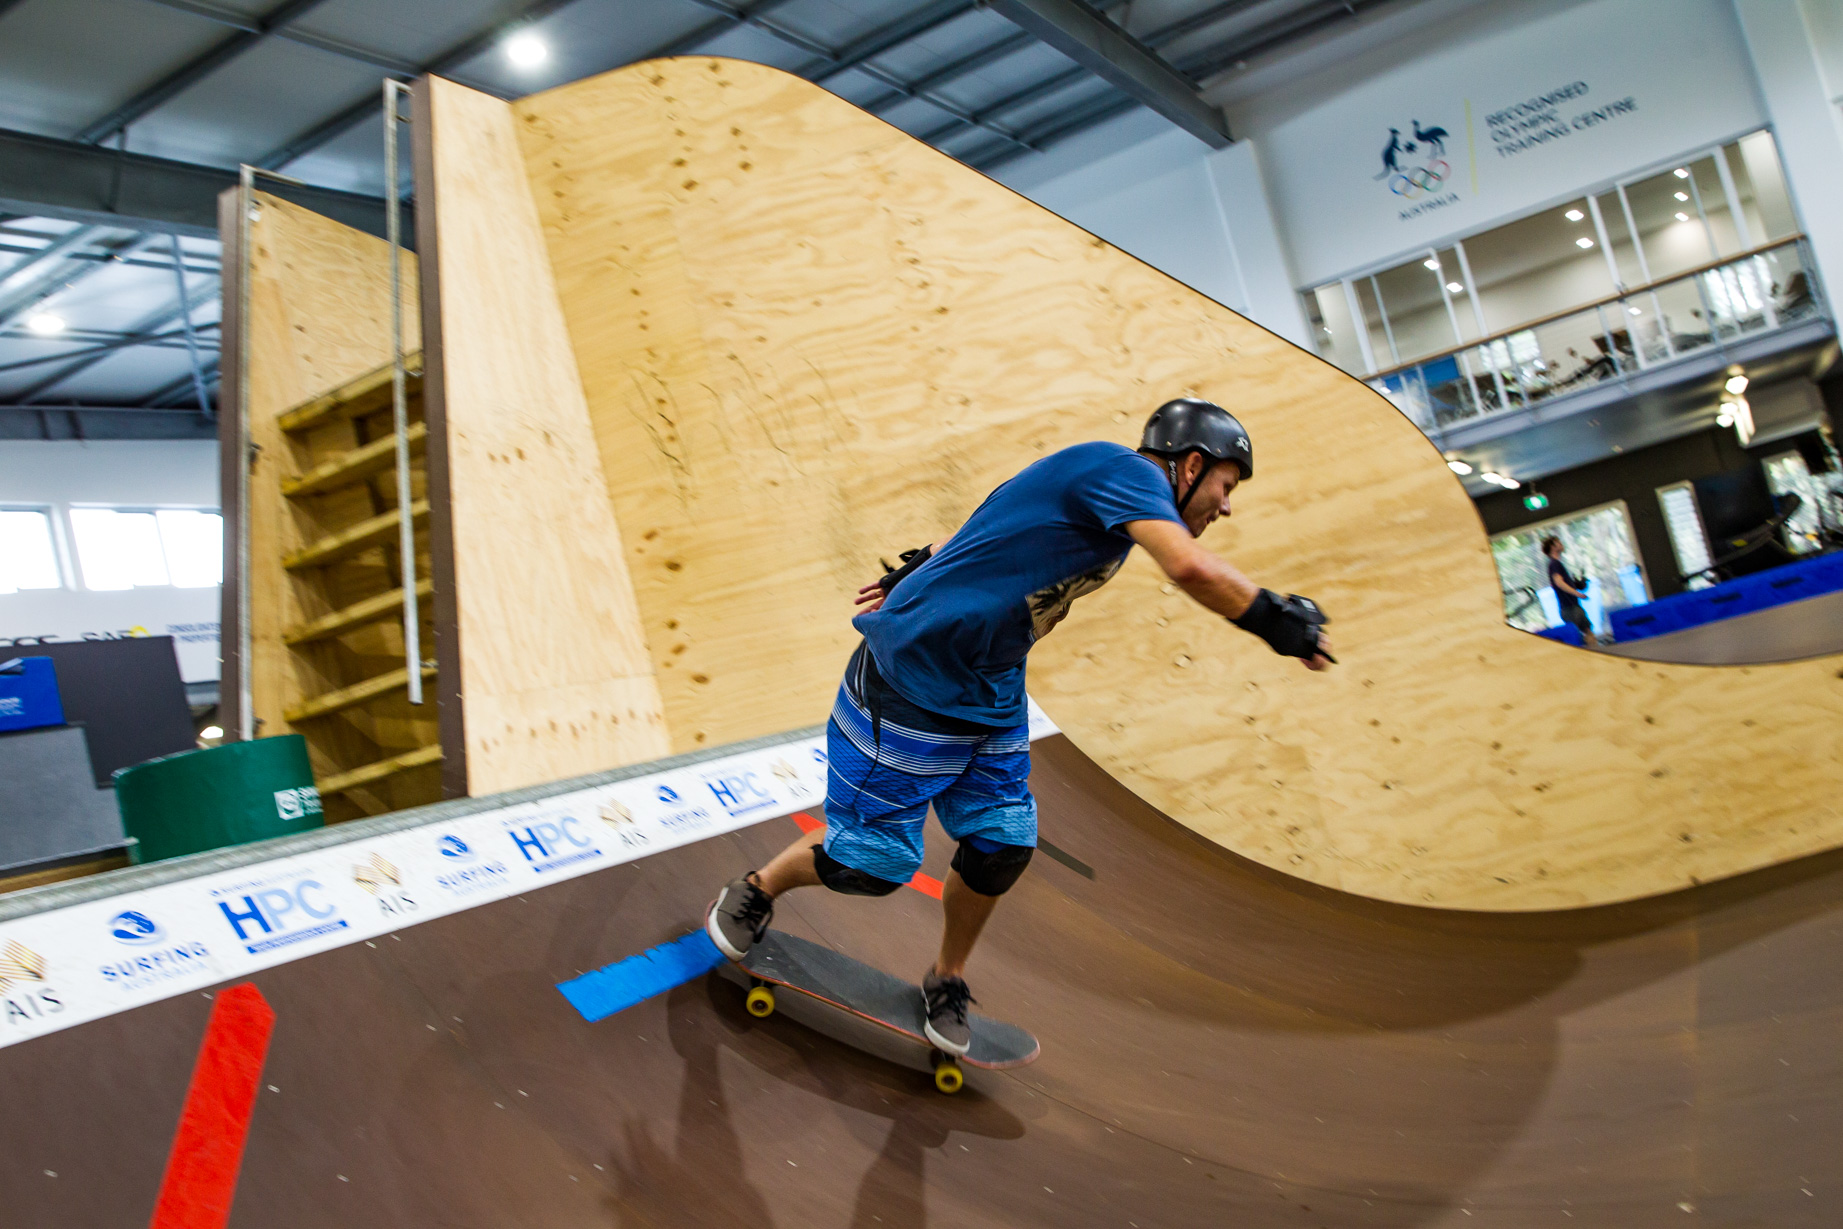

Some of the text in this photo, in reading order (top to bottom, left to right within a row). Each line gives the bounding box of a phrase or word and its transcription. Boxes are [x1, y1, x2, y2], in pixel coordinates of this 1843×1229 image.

[1485, 80, 1590, 128] RECOGNISED
[1490, 108, 1559, 144] OLYMPIC
[1496, 96, 1639, 158] TRAINING CENTRE
[1398, 192, 1461, 221] AUSTRALIA
[706, 772, 770, 808] HPC
[507, 816, 592, 861] HPC
[436, 860, 509, 890] SURFING
[217, 879, 337, 940] HPC
[377, 891, 419, 918] AIS
[99, 941, 211, 982] SURFING
[6, 988, 65, 1024] AIS
